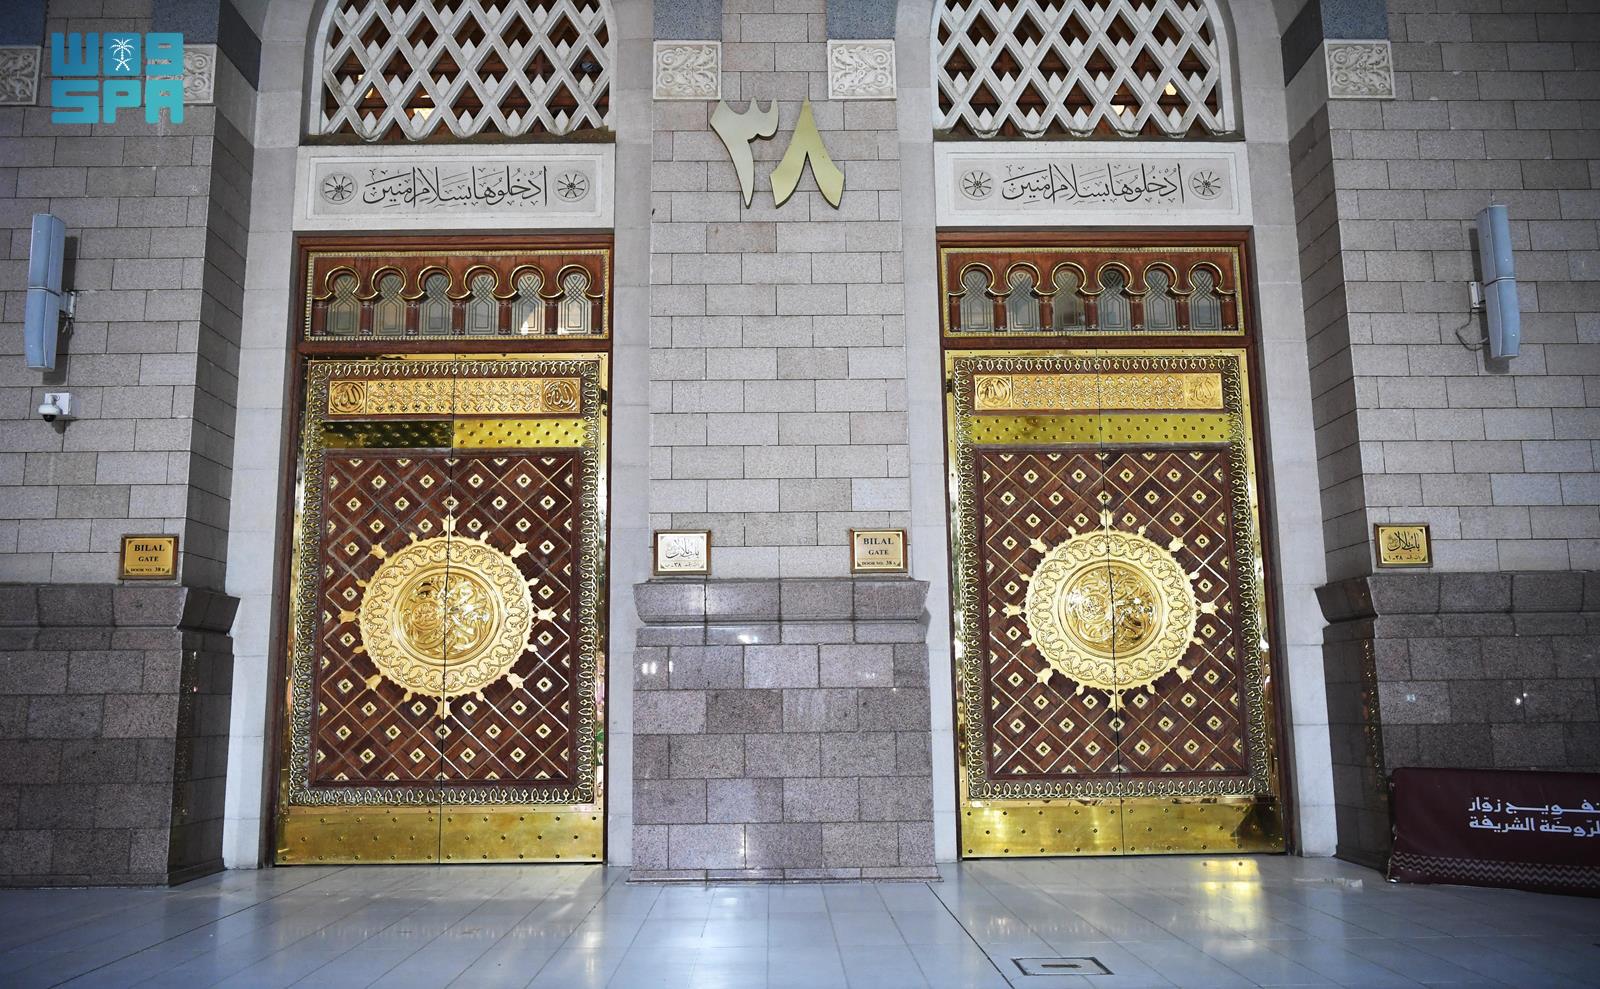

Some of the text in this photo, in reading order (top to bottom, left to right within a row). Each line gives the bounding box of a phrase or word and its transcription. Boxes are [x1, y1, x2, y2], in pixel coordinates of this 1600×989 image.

[709, 96, 846, 210] ٣٨
[863, 537, 894, 545] BILAL
[134, 544, 165, 552] BILAL
[1469, 815, 1535, 833] الشريفة
